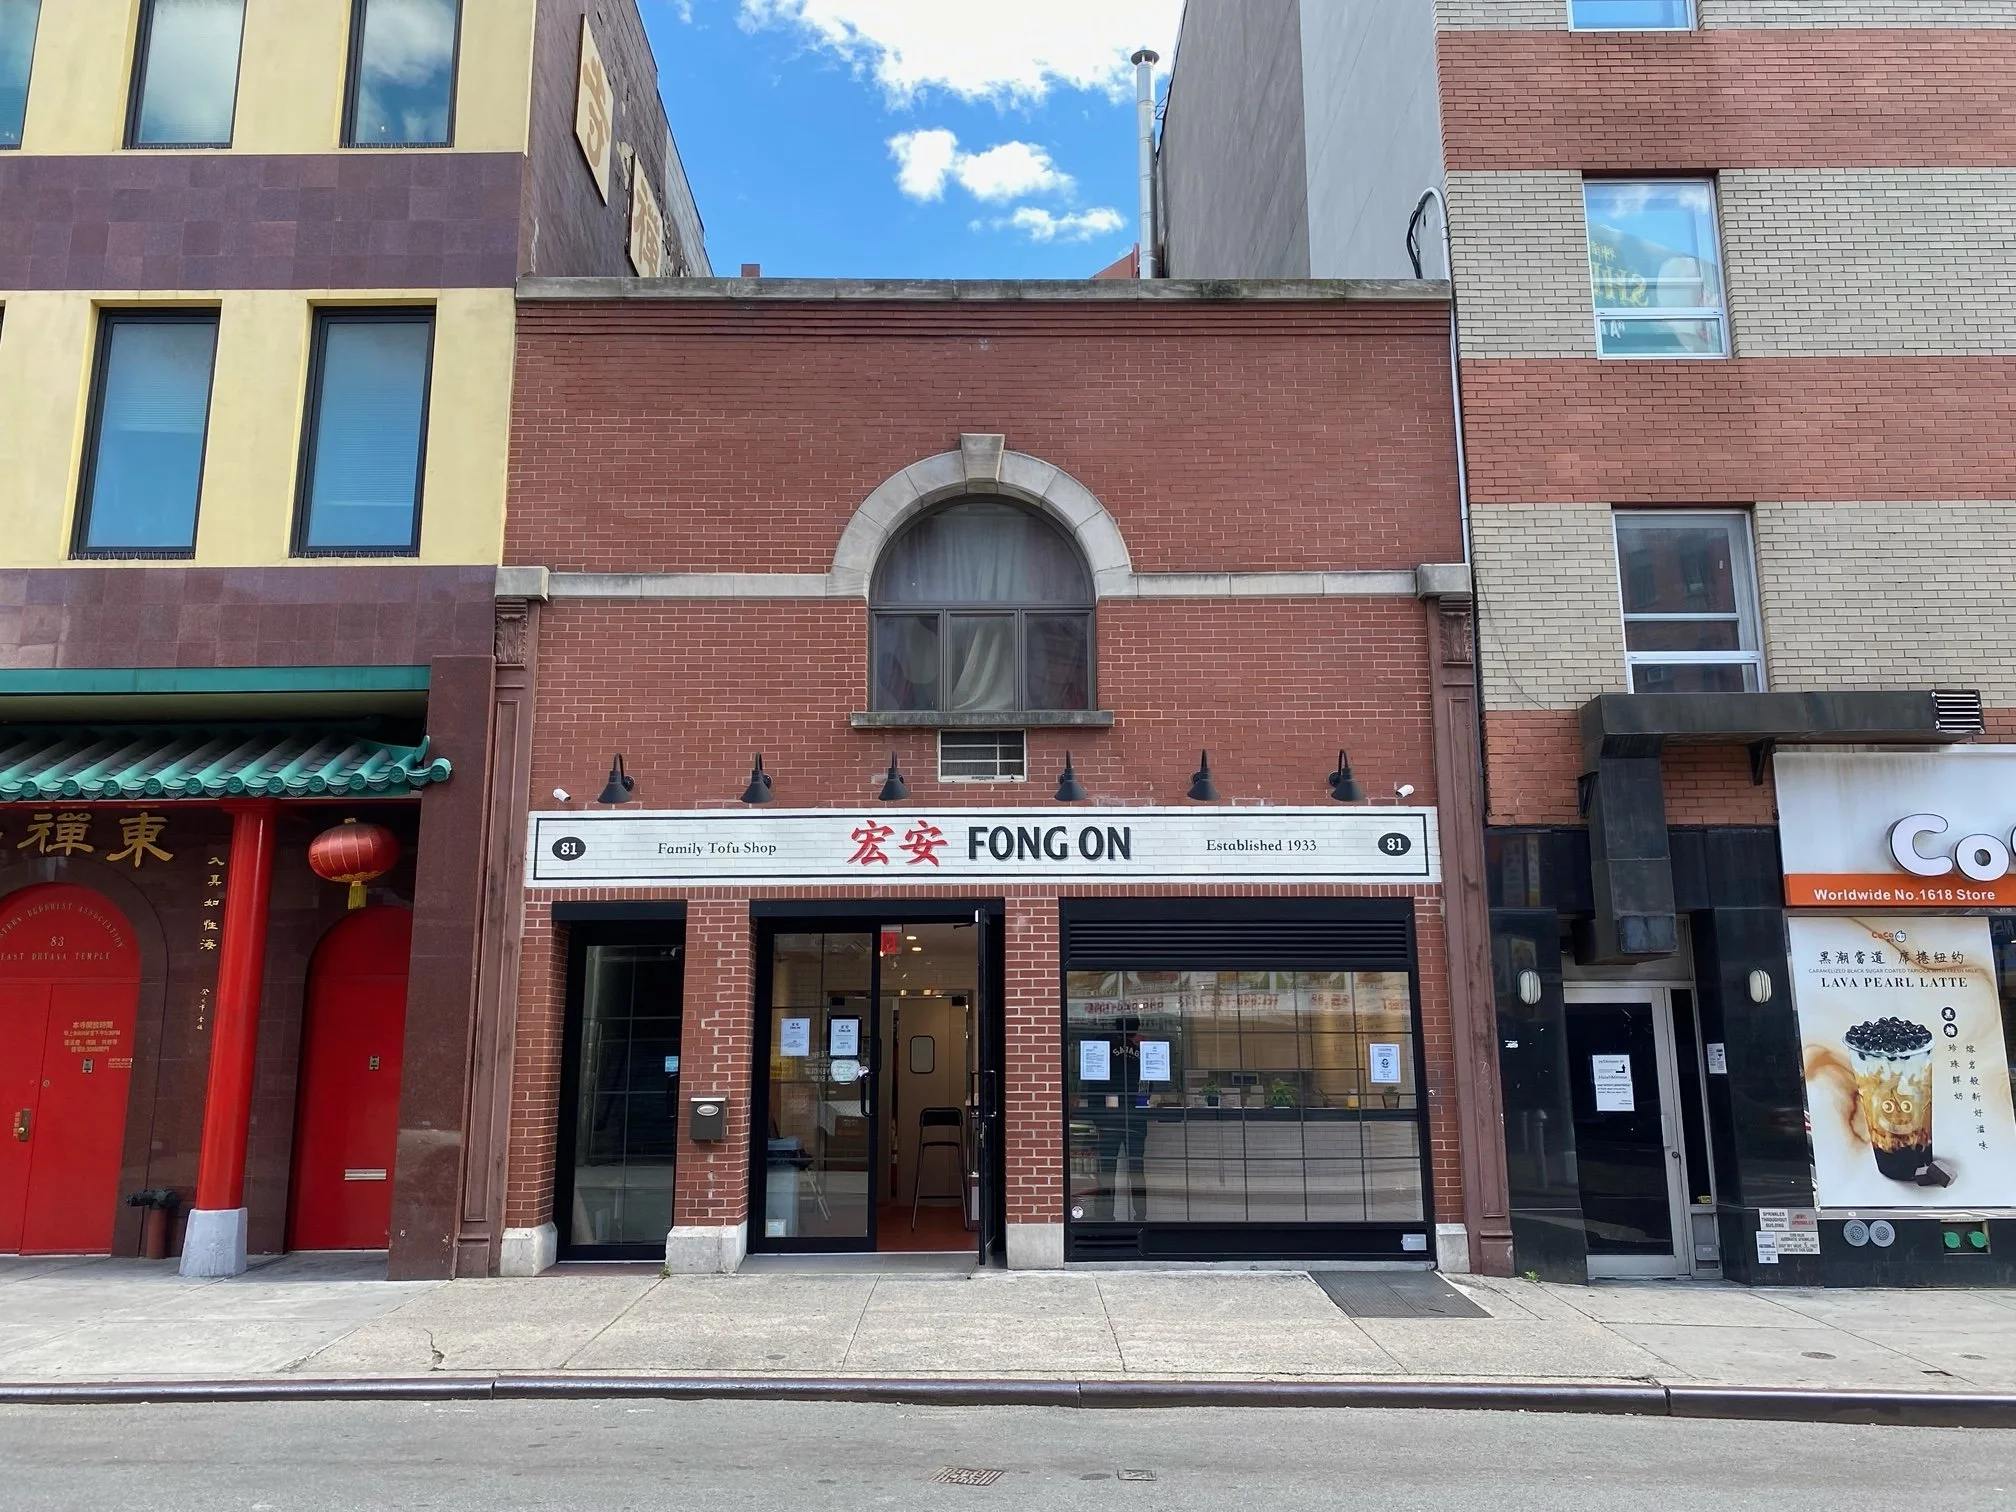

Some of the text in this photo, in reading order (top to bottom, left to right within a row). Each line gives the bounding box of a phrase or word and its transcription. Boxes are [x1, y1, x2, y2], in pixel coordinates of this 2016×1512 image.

[560, 842, 578, 855] 81
[657, 841, 777, 857] Family Tofu Shop
[846, 819, 949, 867] 宏安
[967, 825, 1132, 861] FONG ON
[1206, 839, 1317, 851] Established 1933
[1386, 837, 1404, 851] 81
[1886, 813, 2016, 882] Co
[1813, 888, 1996, 901] Worldwide No.1618 Store
[50, 935, 65, 947] 83
[75, 952, 111, 960] TEMPLE
[1818, 950, 1886, 965] 黑潮當道
[1822, 977, 1968, 988] LAVA PEARL LATTE
[1112, 1045, 1140, 1058] SAVAG
